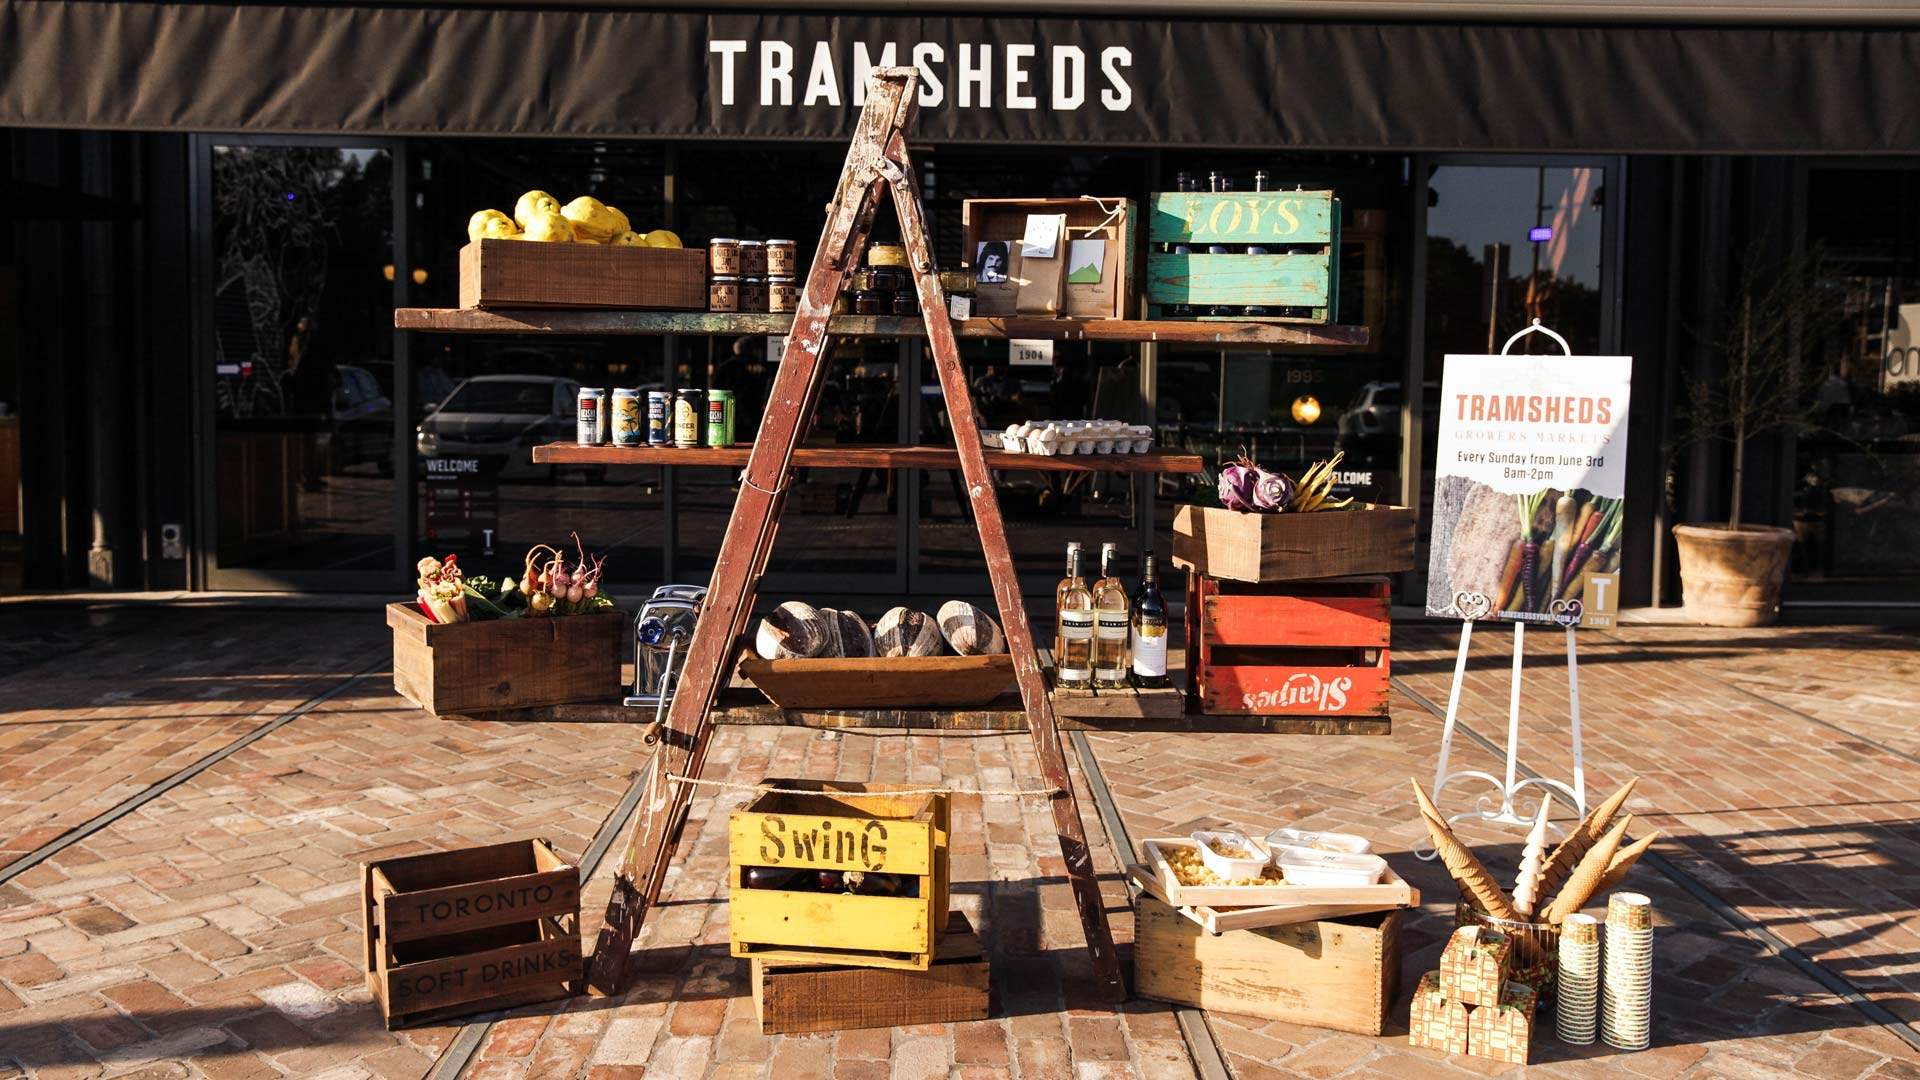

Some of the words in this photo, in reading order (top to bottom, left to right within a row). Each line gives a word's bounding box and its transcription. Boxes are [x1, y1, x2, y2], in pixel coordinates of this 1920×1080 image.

[709, 39, 1133, 112] TRAMSHEDS
[1456, 394, 1612, 425] TRAMSHEDS
[426, 459, 479, 473] WELCOME
[1457, 450, 1485, 464] Every
[1488, 452, 1526, 465] Sunday
[1530, 455, 1554, 465] from
[1558, 454, 1583, 467] June
[1586, 455, 1604, 467] 3rd
[1503, 467, 1554, 481] 8am-2pm
[1331, 470, 1373, 486] LCOME
[1591, 577, 1612, 611] T
[416, 884, 554, 924] TORONTO
[399, 967, 470, 999] SOFT
[482, 949, 572, 984] DRINKS
